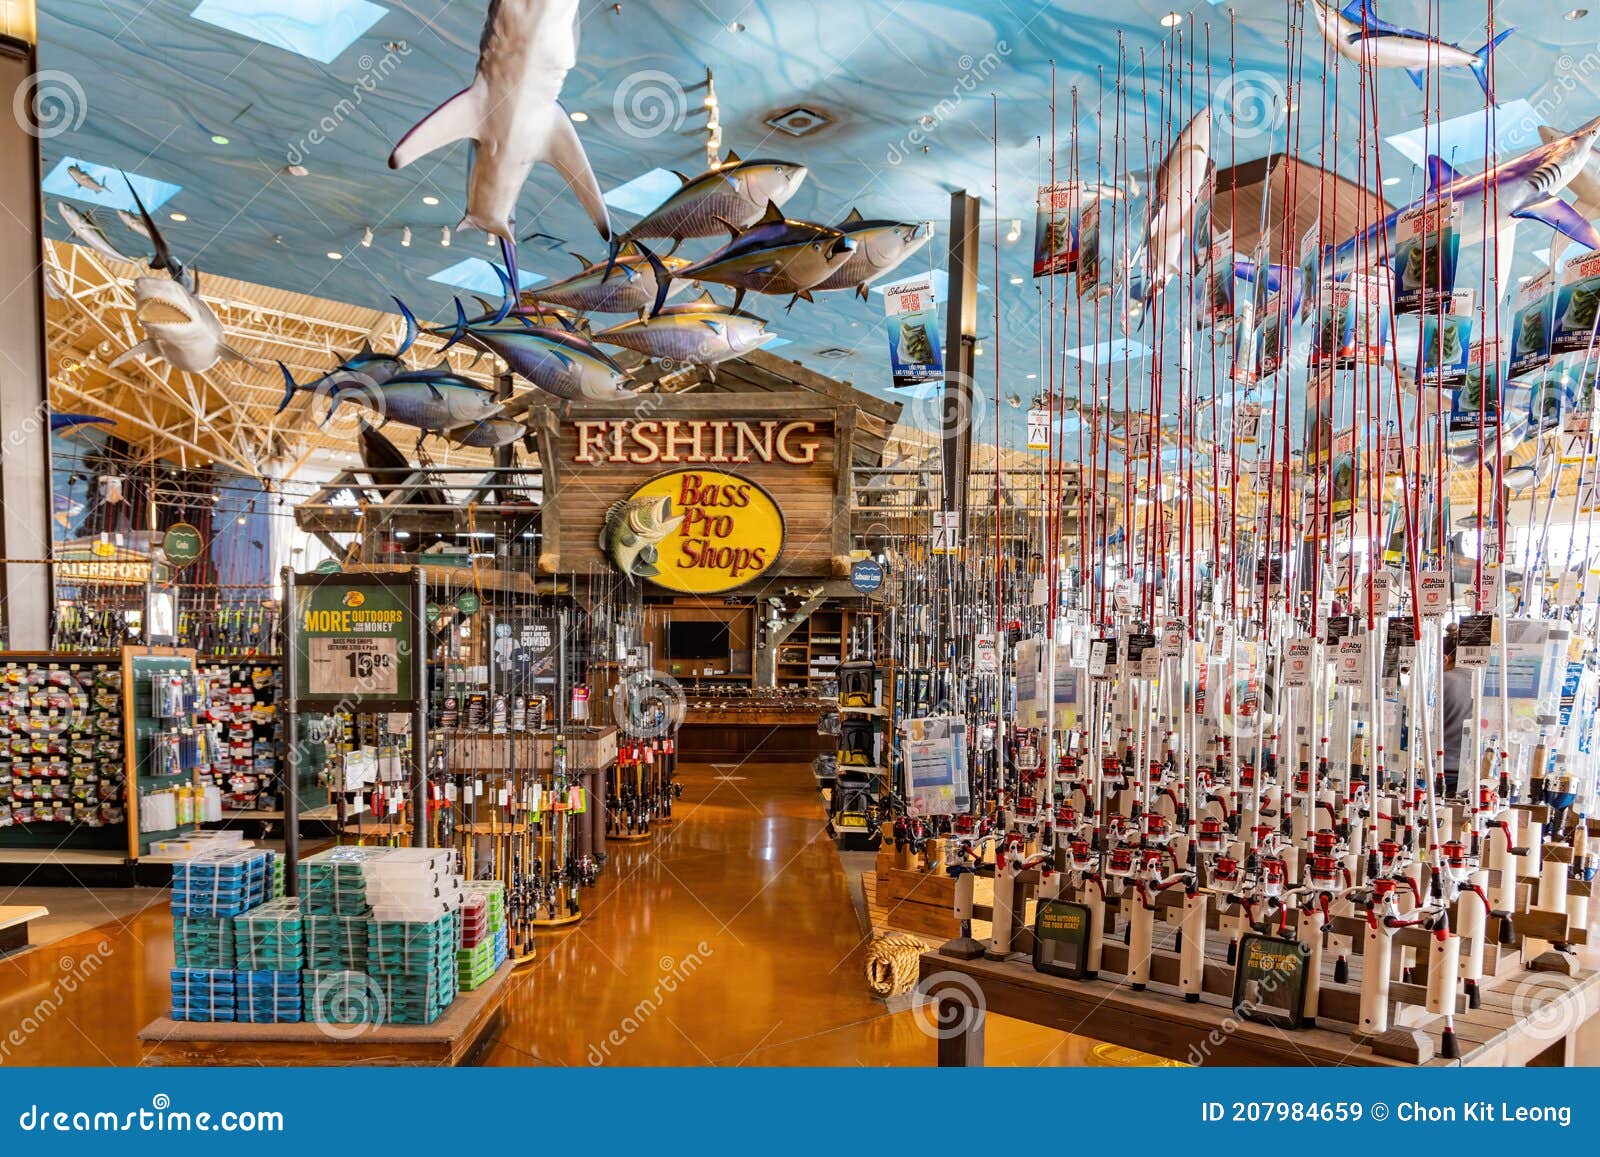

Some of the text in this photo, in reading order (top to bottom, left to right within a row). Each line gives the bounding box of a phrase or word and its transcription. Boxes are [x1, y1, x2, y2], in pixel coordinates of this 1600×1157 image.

[574, 420, 820, 464] FISHING
[678, 473, 751, 508] Bass
[679, 507, 734, 538] Pro
[677, 538, 765, 577] Shops
[304, 610, 403, 633] MORE OUTDOORS
[364, 622, 393, 632] MONEY
